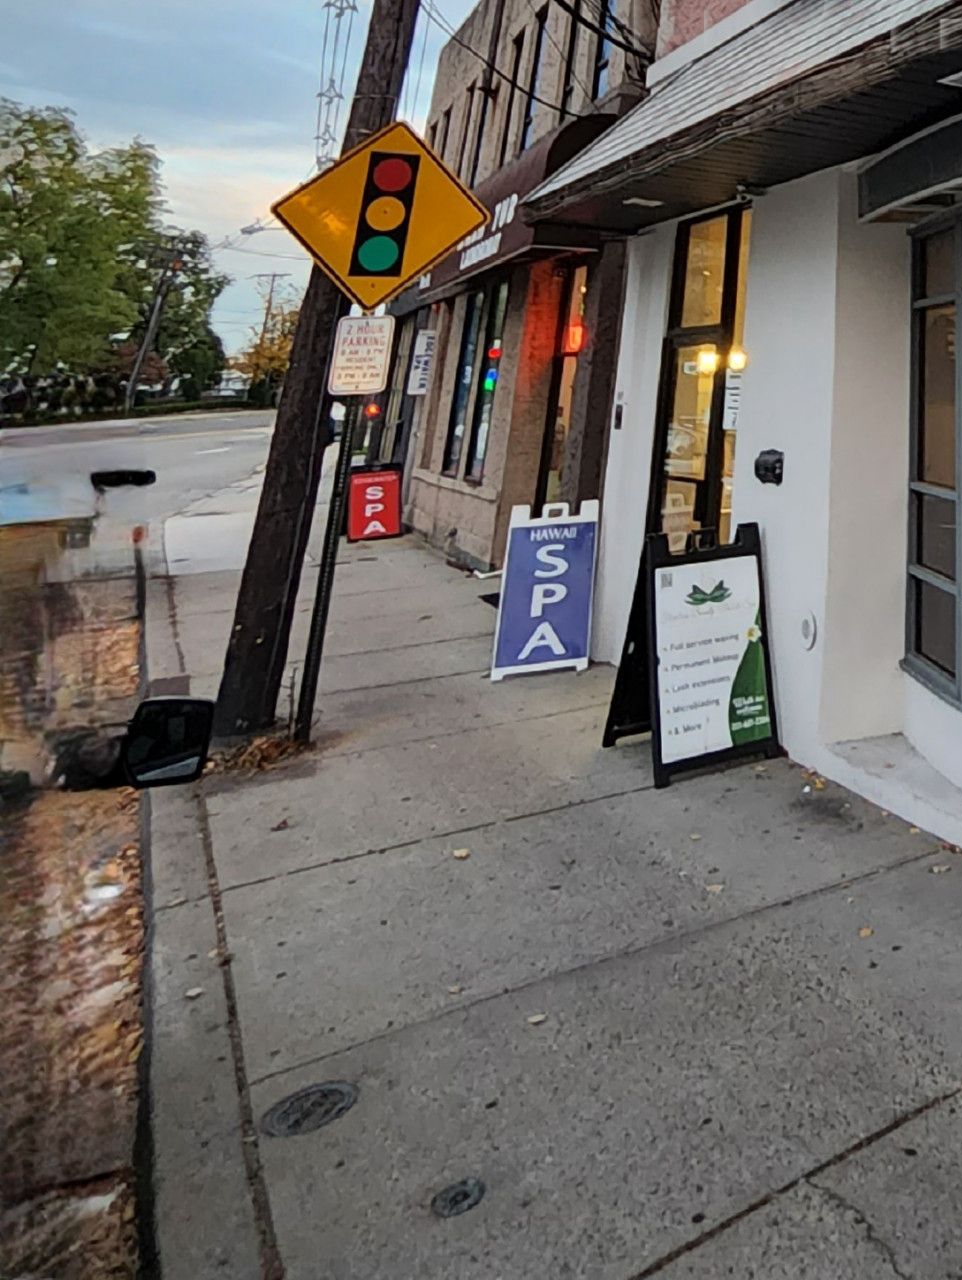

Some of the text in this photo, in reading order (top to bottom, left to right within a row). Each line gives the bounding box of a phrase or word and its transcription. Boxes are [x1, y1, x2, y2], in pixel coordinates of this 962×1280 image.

[356, 324, 384, 335] HOUR
[341, 335, 386, 347] PARKING
[363, 485, 388, 535] SPA
[530, 526, 577, 542] HAWAII
[517, 543, 569, 660] SPA
